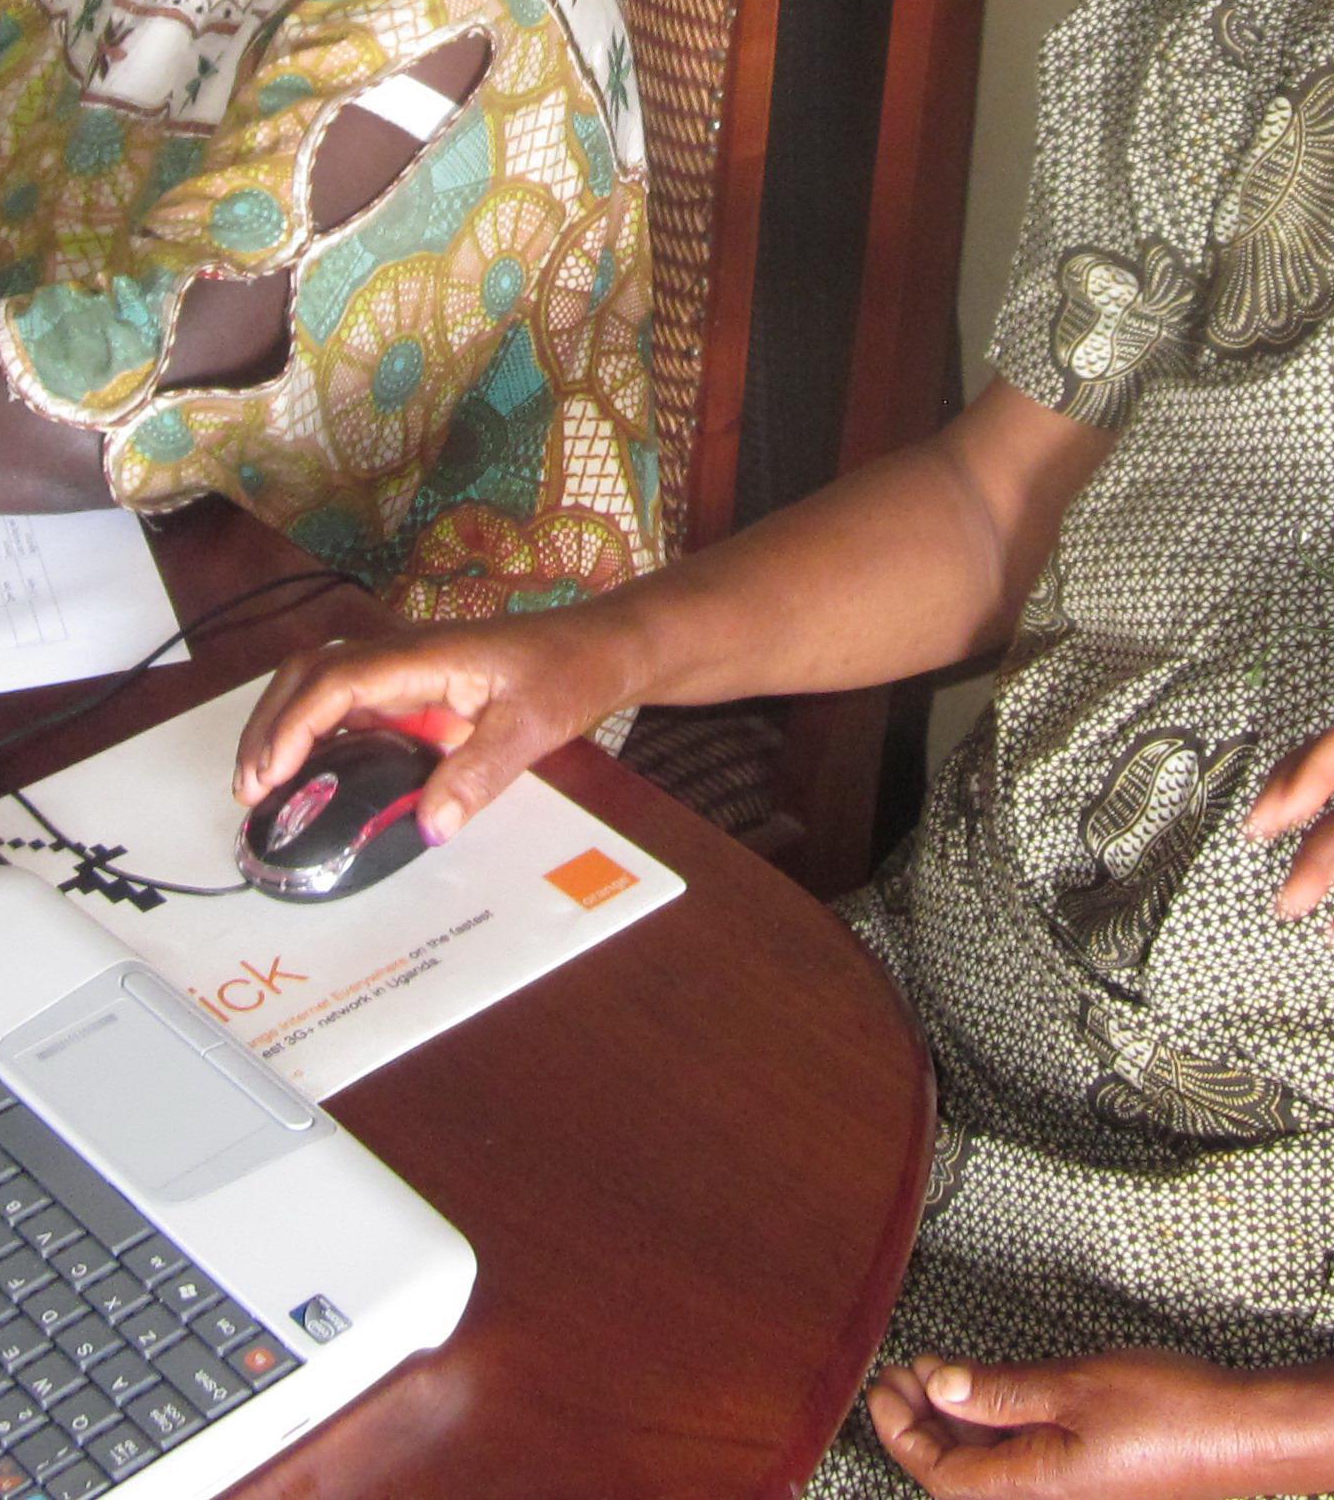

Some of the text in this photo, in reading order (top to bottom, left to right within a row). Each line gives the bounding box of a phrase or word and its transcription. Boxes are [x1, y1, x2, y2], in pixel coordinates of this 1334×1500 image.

[409, 945, 427, 960] on
[426, 933, 451, 950] the
[449, 908, 495, 937] fastest
[186, 955, 311, 1024] ick
[317, 993, 373, 1030] network
[372, 984, 387, 998] in
